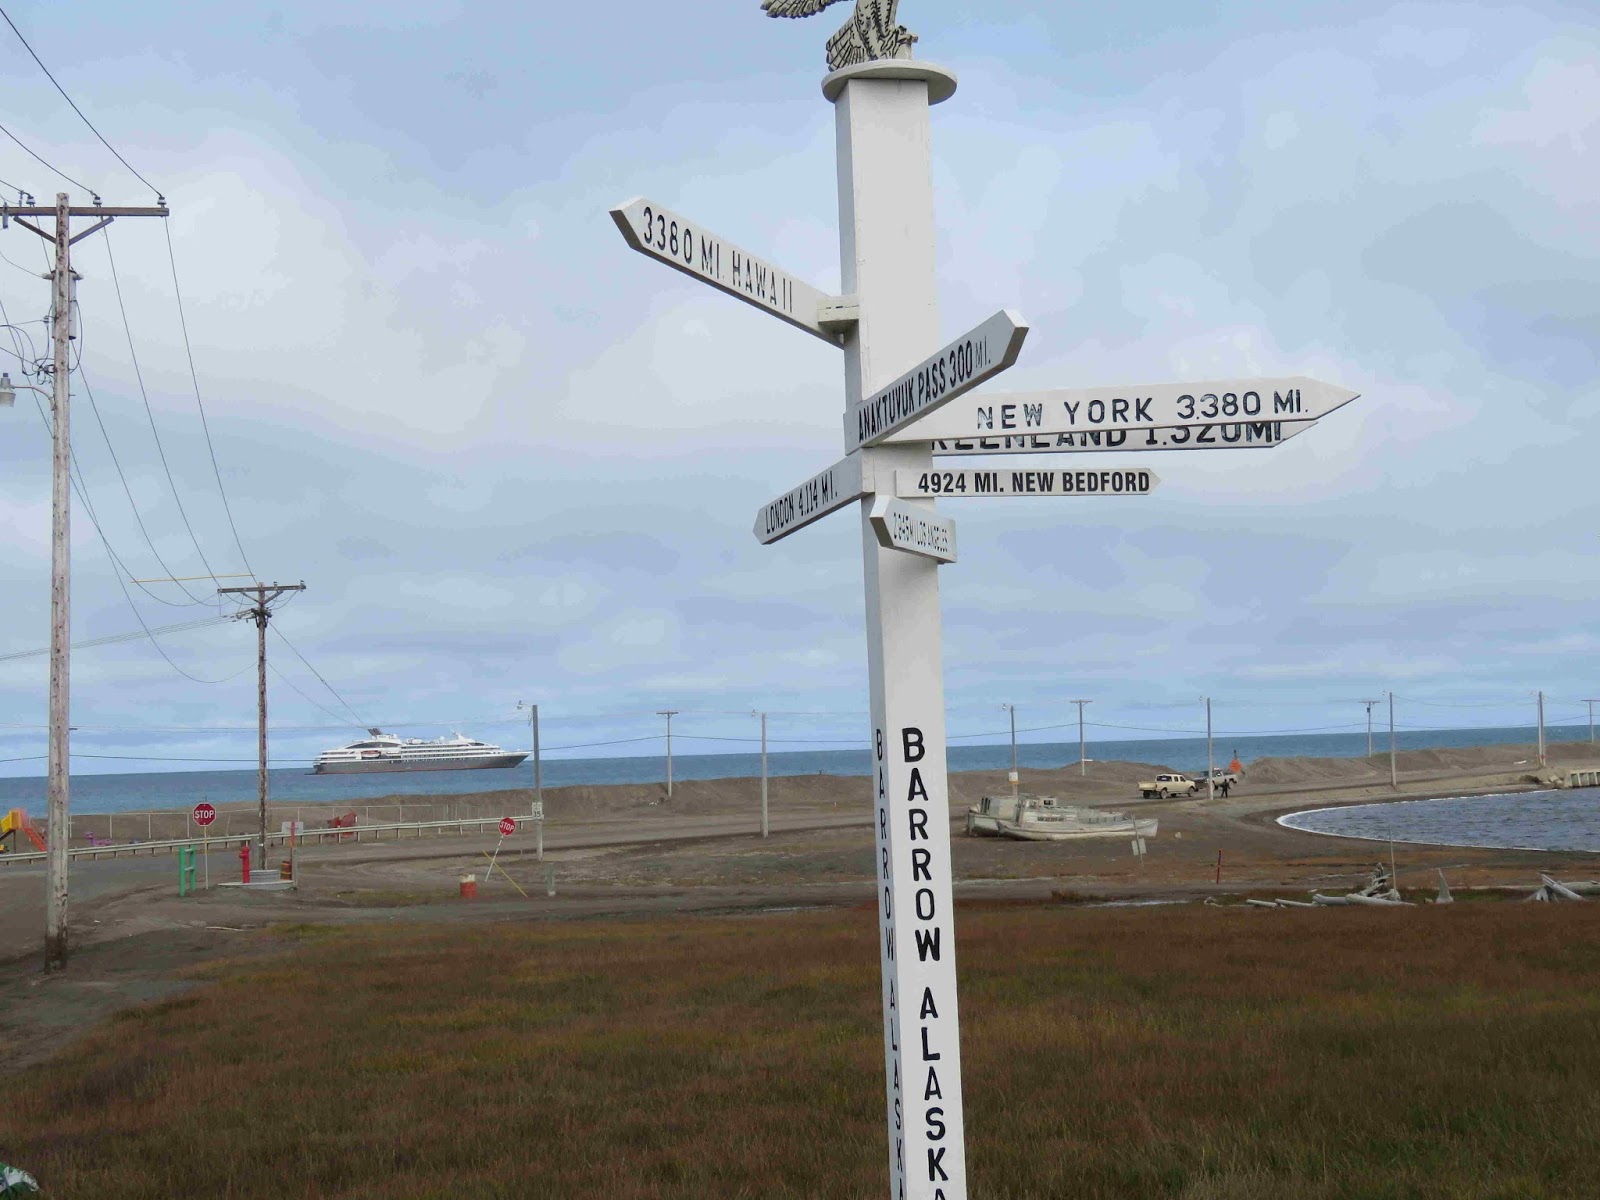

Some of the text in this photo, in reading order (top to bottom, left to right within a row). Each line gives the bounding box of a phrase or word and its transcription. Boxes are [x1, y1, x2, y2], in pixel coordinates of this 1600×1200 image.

[643, 206, 693, 264] 3.380
[732, 250, 793, 313] HAWAII
[858, 376, 915, 443] ANAKTUVUK
[918, 357, 946, 407] PASS
[949, 340, 973, 388] 300
[977, 389, 1309, 430] NEW YORK 3.380 MI.
[918, 471, 1150, 493] 4924 MI. NEW BEDFORD
[765, 493, 795, 534] LONDON
[194, 810, 215, 819] STOP
[499, 820, 515, 832] STOP
[902, 727, 941, 961] BARROW
[876, 729, 904, 1200] BARROW ALASKA
